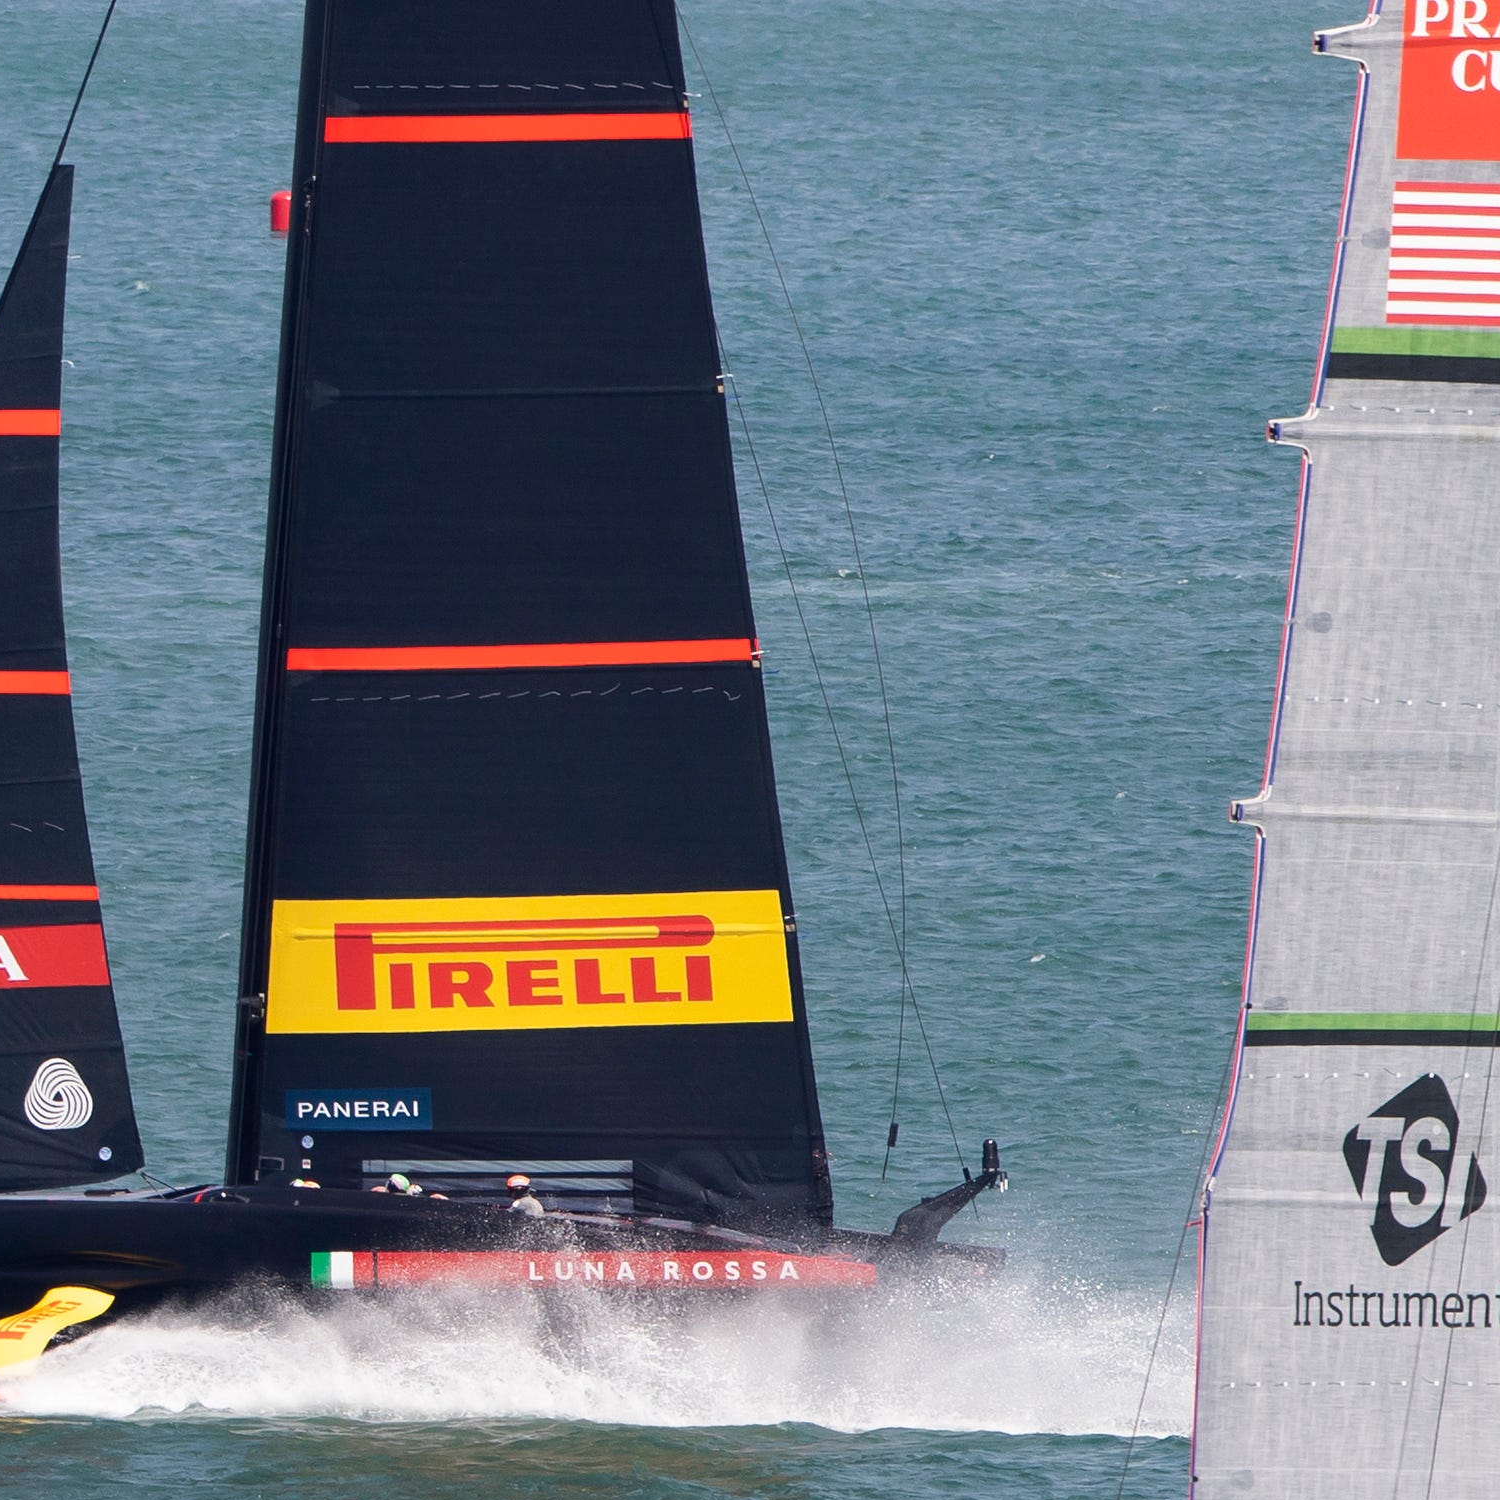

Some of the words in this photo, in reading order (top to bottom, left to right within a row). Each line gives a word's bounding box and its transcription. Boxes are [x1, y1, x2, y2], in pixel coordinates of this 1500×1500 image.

[334, 915, 715, 1010] PIRELLI
[298, 1100, 419, 1119] PANERAI
[529, 1261, 635, 1281] LUNA
[663, 1261, 799, 1281] ROSSA
